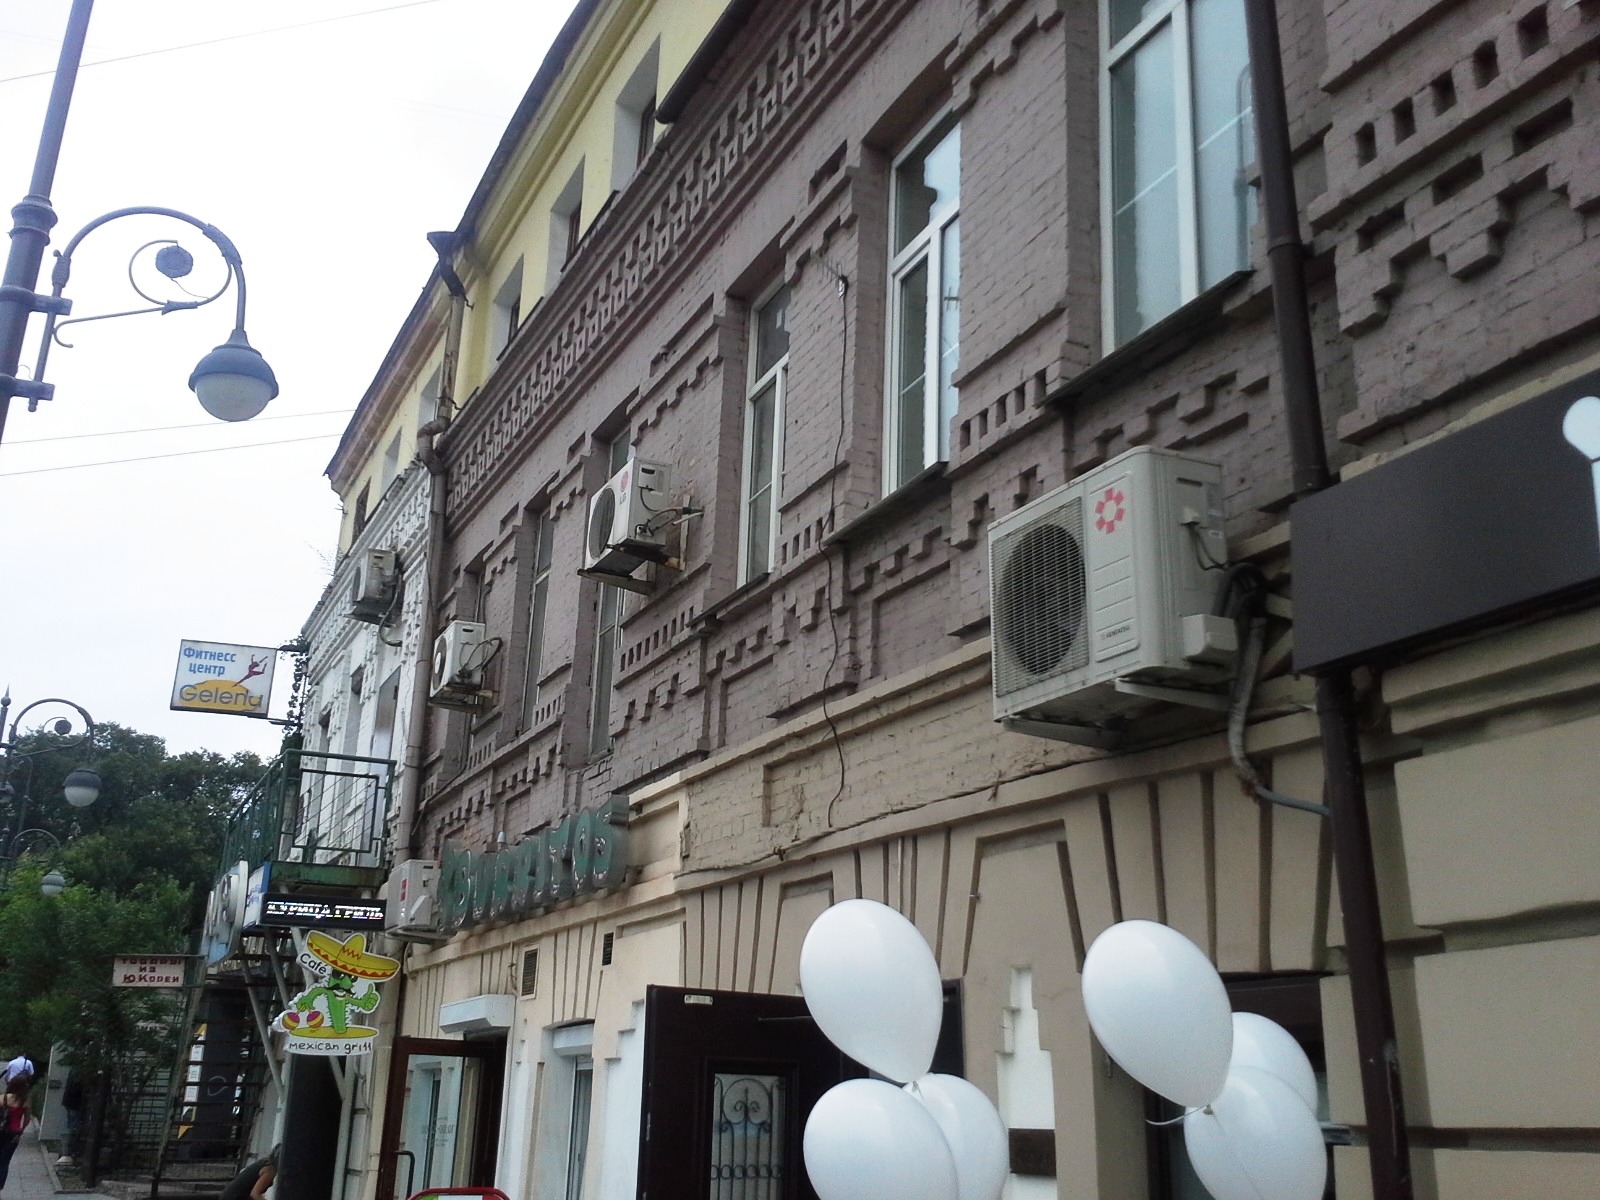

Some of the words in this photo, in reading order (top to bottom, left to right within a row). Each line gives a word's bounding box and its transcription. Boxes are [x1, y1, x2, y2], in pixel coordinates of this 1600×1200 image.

[183, 647, 237, 662] Фитнесс
[188, 662, 226, 677] центр
[180, 684, 264, 707] Gelena
[300, 953, 327, 975] Café
[289, 1042, 339, 1051] mexican
